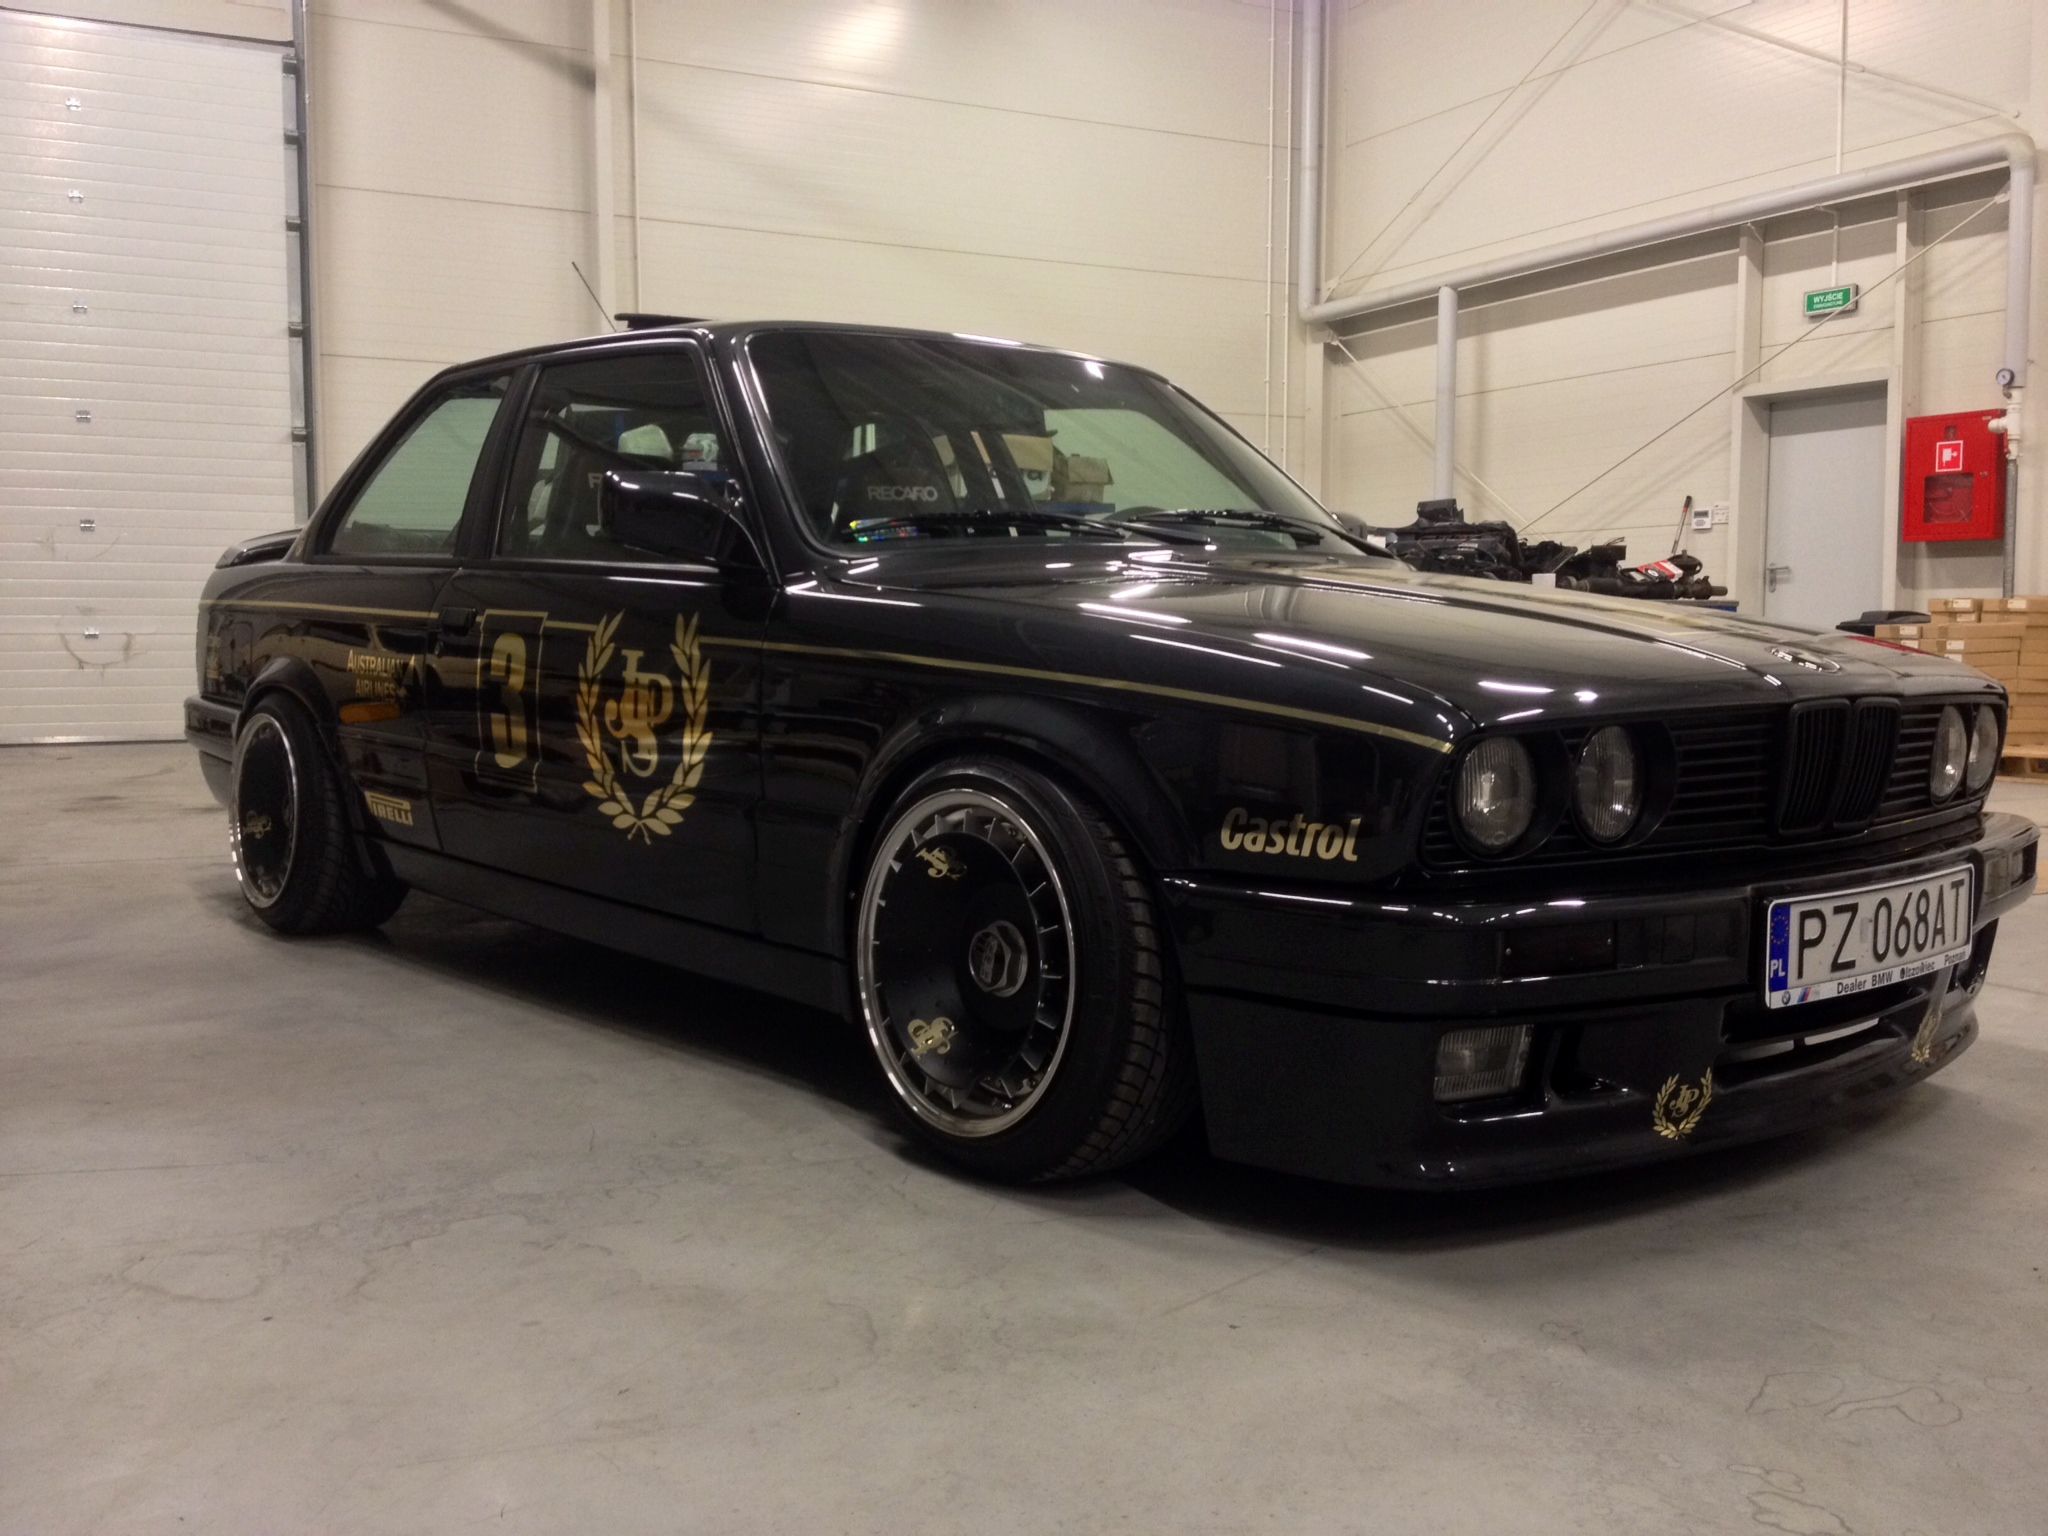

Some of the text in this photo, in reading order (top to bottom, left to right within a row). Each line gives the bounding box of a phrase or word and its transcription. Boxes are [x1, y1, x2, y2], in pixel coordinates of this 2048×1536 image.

[867, 486, 938, 501] RECARO
[491, 633, 527, 768] 3
[364, 791, 414, 826] PIRELLI
[1220, 807, 1362, 862] Castrol
[1797, 878, 1965, 980] PZ 068AT
[1770, 959, 1786, 978] PL
[1837, 979, 1867, 995] Dealer
[1871, 970, 1893, 987] BMW
